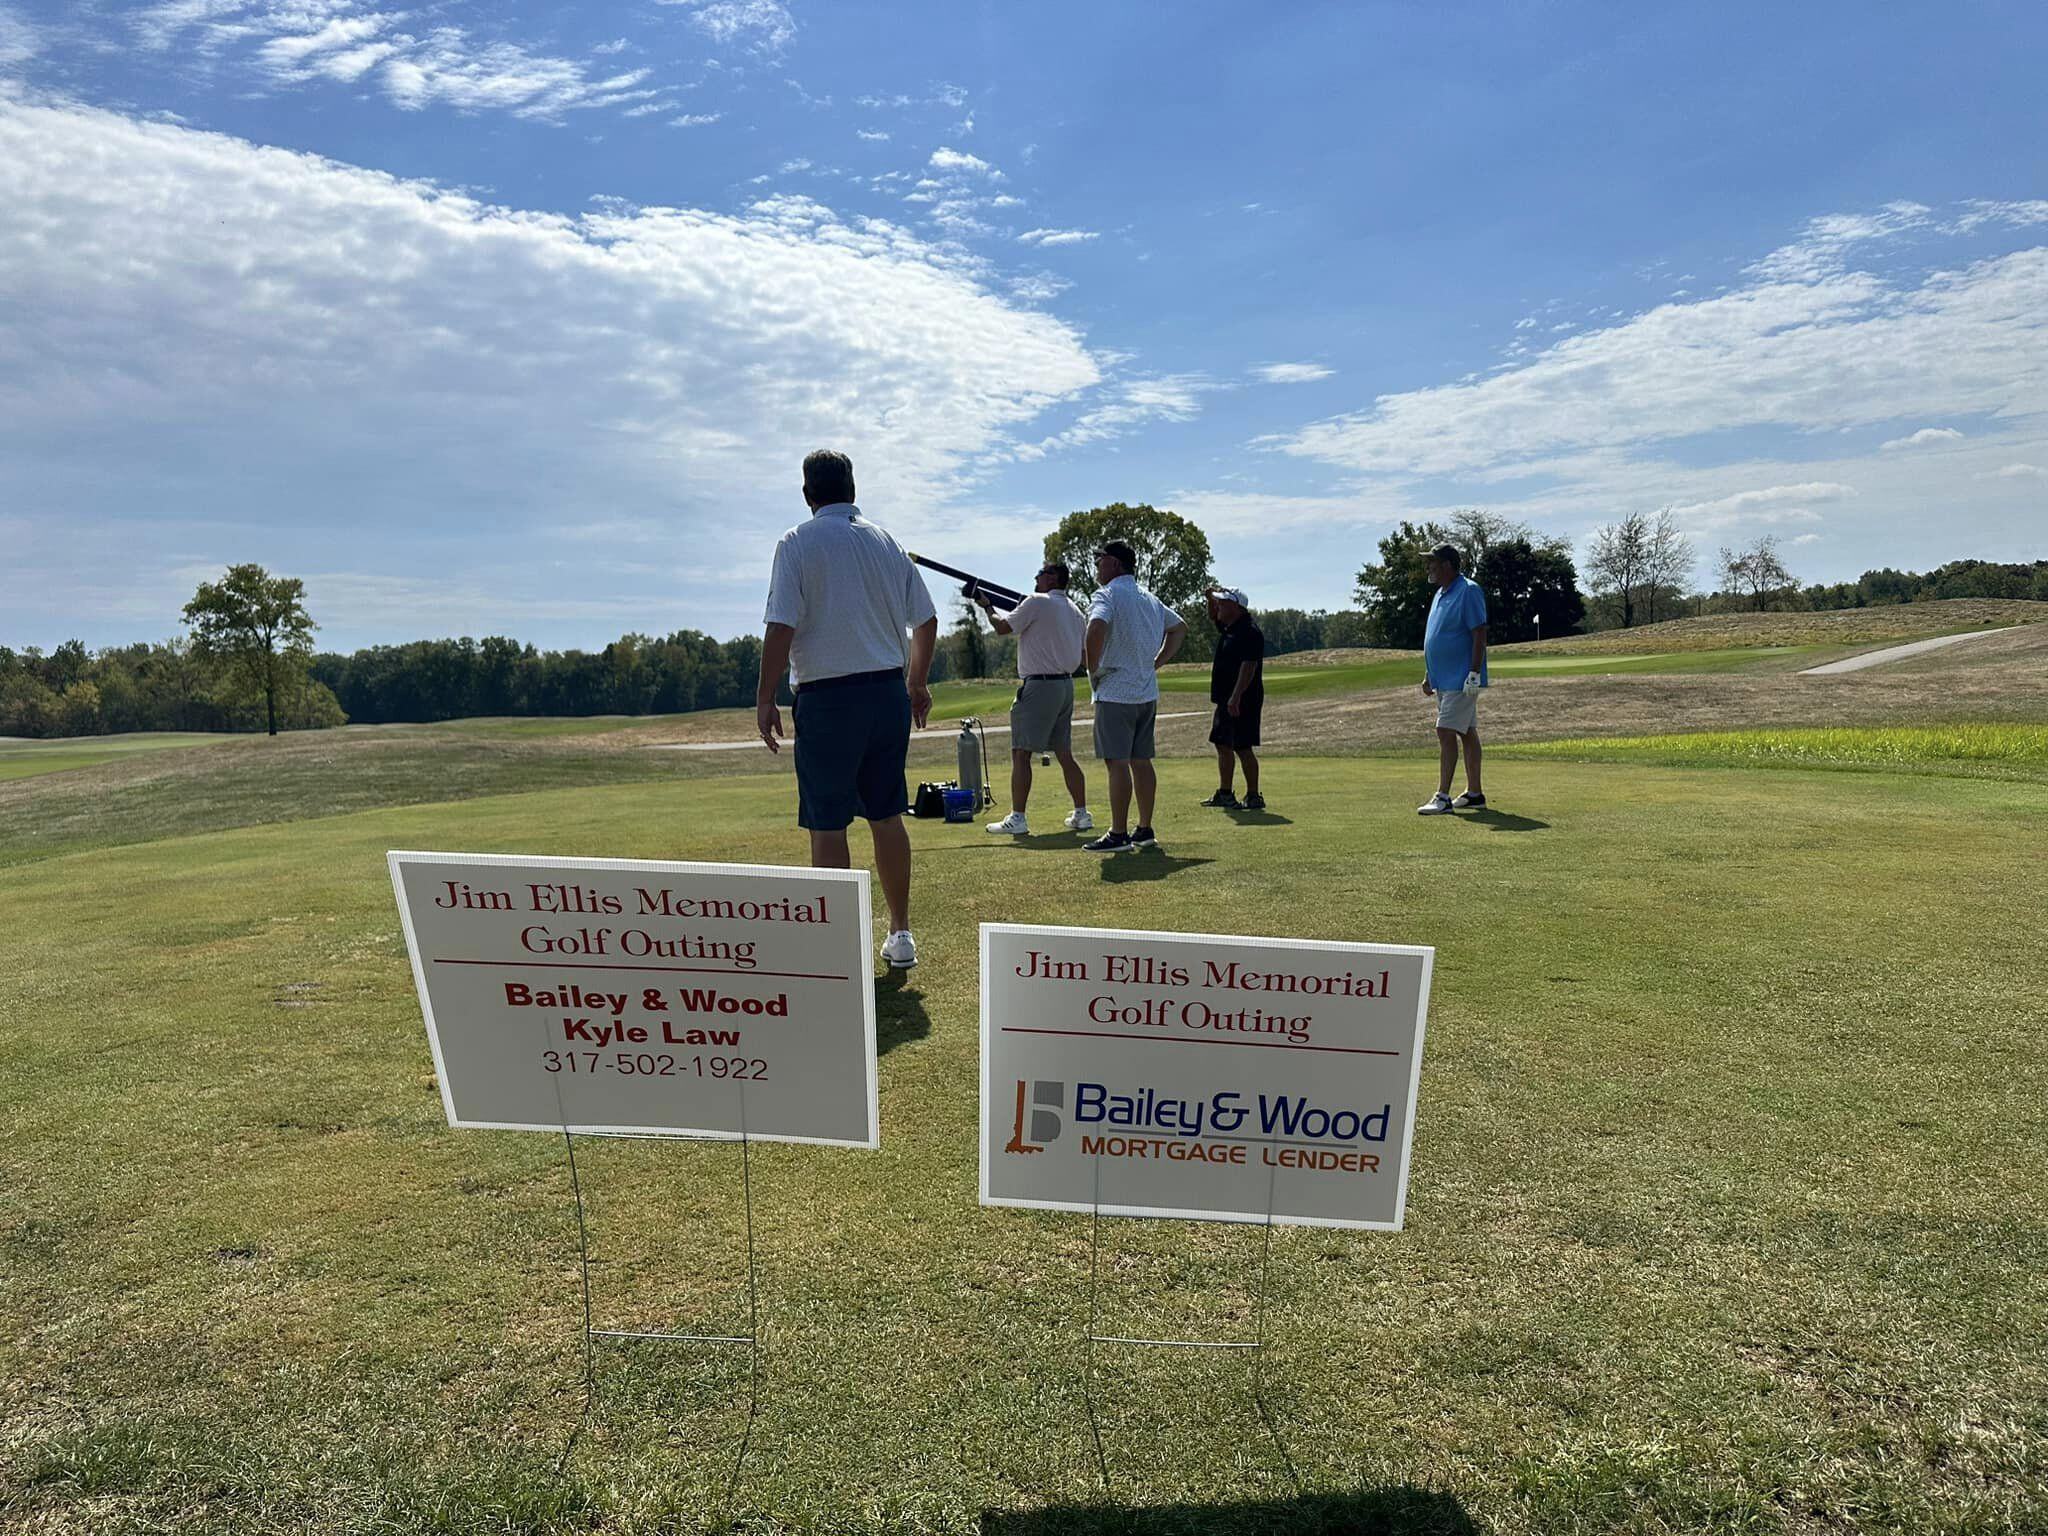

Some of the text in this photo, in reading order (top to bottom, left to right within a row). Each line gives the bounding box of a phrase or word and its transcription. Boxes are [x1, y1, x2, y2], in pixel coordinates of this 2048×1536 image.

[435, 881, 831, 924] Jim Ellis Memorial
[521, 926, 756, 969] Golf Outing
[1016, 951, 1390, 999] Jim Ellis Memorial
[504, 983, 788, 1016] Bailey & Wood
[1087, 995, 1313, 1044] Golf Outing
[563, 1018, 740, 1048] Kyle Law
[543, 1051, 768, 1080] 317-502-1922
[1075, 1082, 1204, 1137] Bailey
[1209, 1092, 1250, 1131] &
[1258, 1095, 1391, 1143] Wood
[1081, 1134, 1381, 1174] MORTGAGE LENDER
